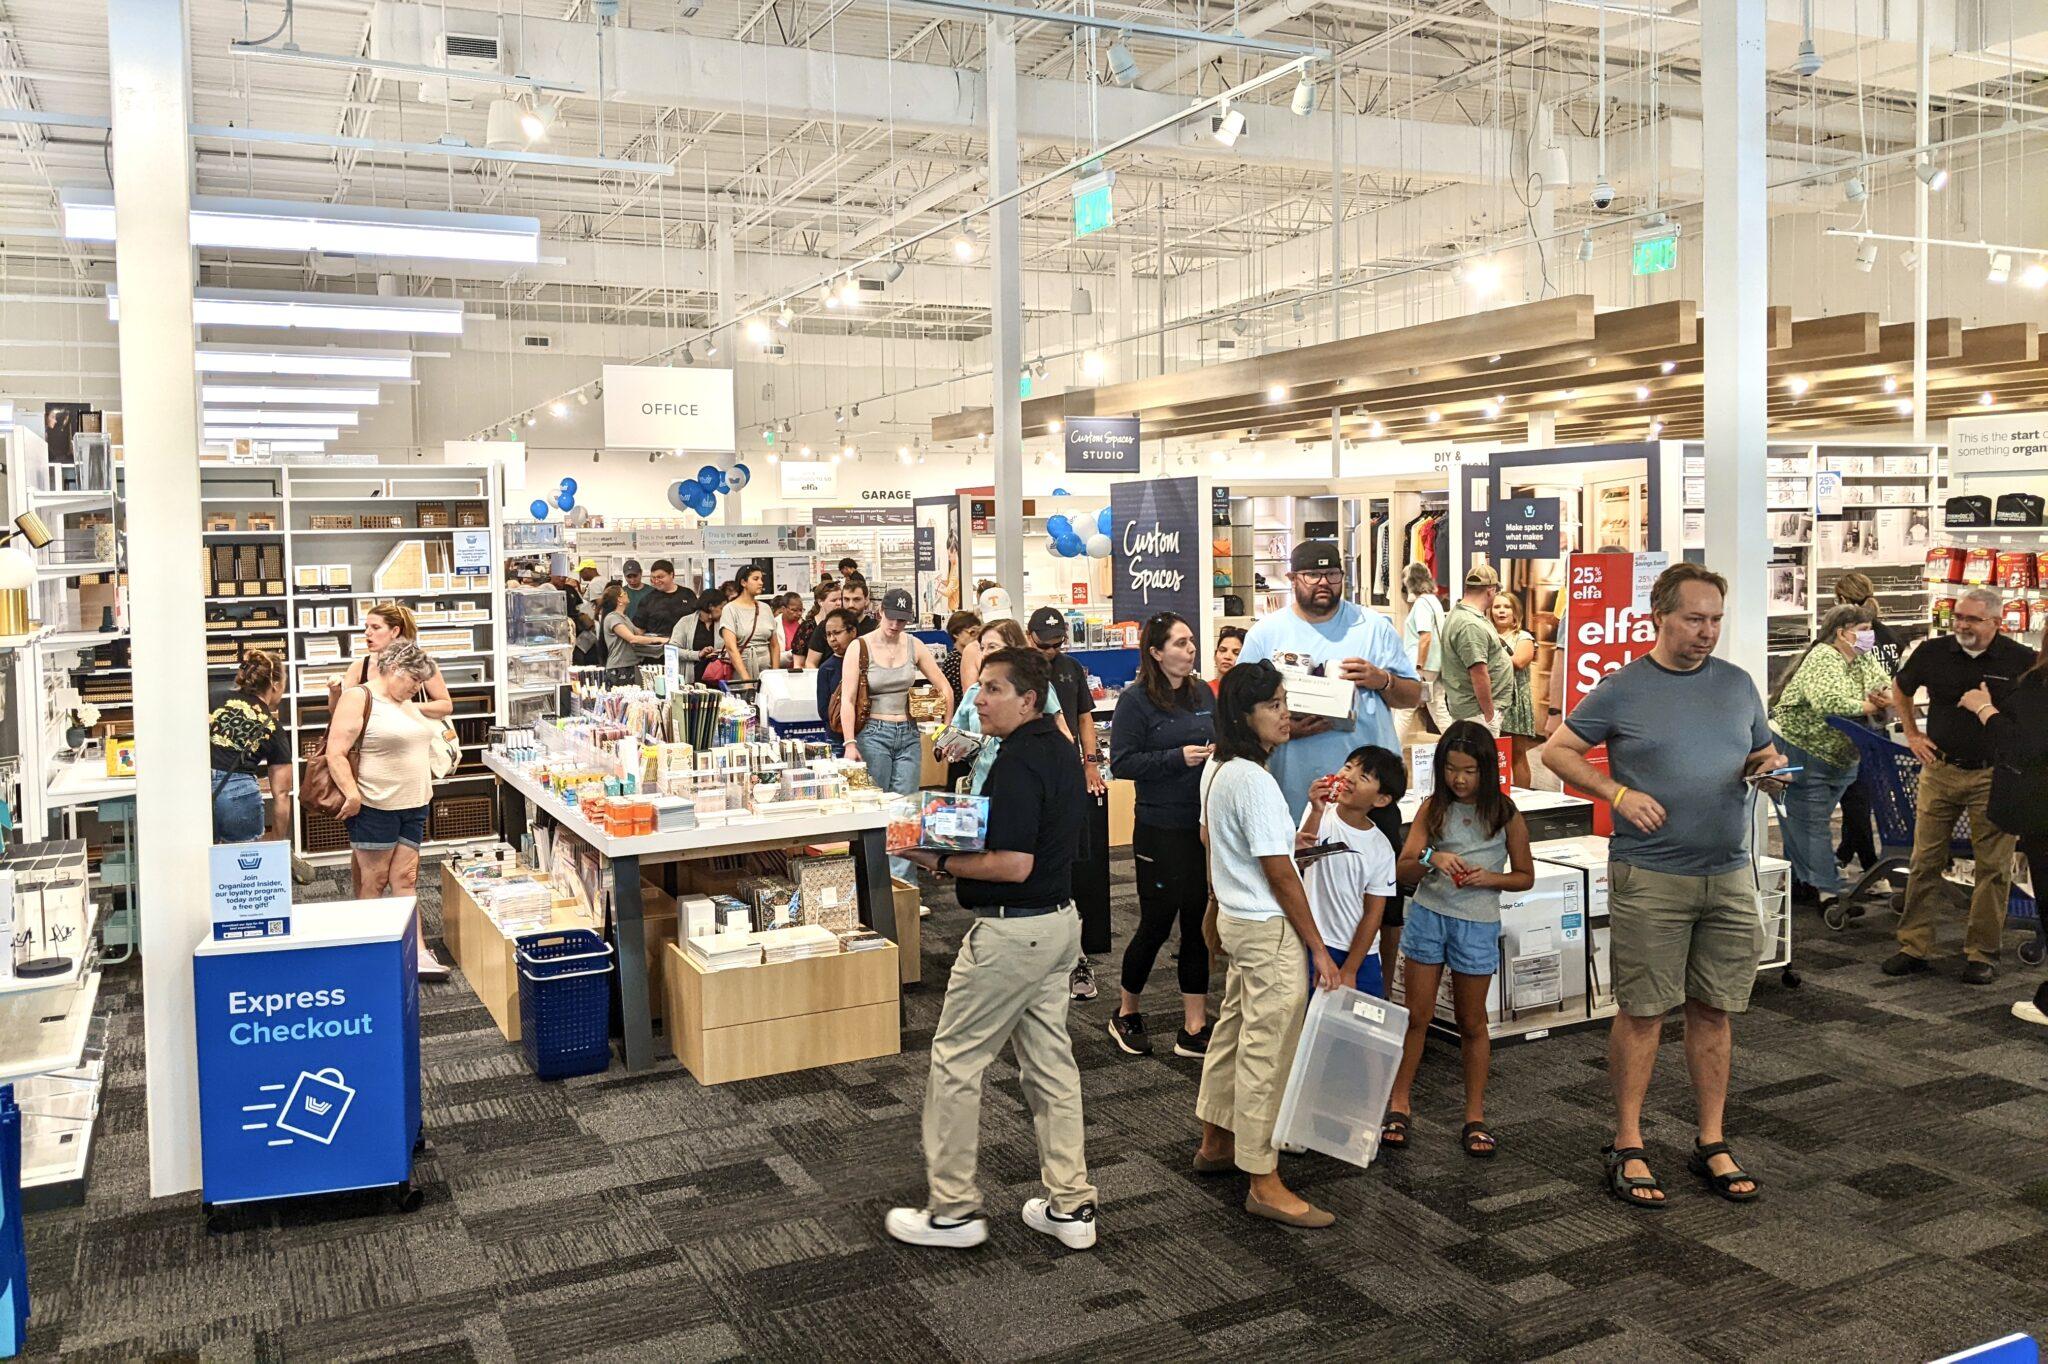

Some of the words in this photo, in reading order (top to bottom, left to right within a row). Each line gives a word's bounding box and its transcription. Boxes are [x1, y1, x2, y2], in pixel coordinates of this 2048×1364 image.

[641, 402, 699, 416] OFFICE
[1070, 429, 1104, 444] Custom
[1103, 430, 1136, 449] Spaces
[1958, 433, 1978, 443] This
[1981, 432, 1989, 442] is
[1992, 431, 2008, 441] the
[2011, 430, 2040, 441] start
[1082, 450, 1124, 460] STUDIO
[1434, 451, 1451, 462] DIY
[1455, 450, 1461, 461] &
[1958, 445, 2010, 457] something
[1819, 477, 1836, 486] 25%
[861, 490, 912, 500] GARAGE
[1819, 486, 1832, 495] Off
[1505, 523, 1523, 531] Make
[1524, 524, 1543, 533] space
[1544, 523, 1554, 531] for
[1123, 519, 1180, 558] Custom
[1474, 538, 1489, 546] style
[1505, 533, 1522, 541] what
[1522, 533, 1544, 541] makes
[1505, 544, 1518, 552] you
[1128, 555, 1185, 605] Spaces
[1572, 585, 1602, 600] elfa
[1578, 606, 1656, 645] elfa
[218, 882, 255, 890] Organized
[229, 889, 252, 897] loyalty
[254, 888, 286, 896] program,
[264, 894, 275, 902] get
[229, 987, 346, 1017] Express
[229, 1013, 373, 1046] Checkout
